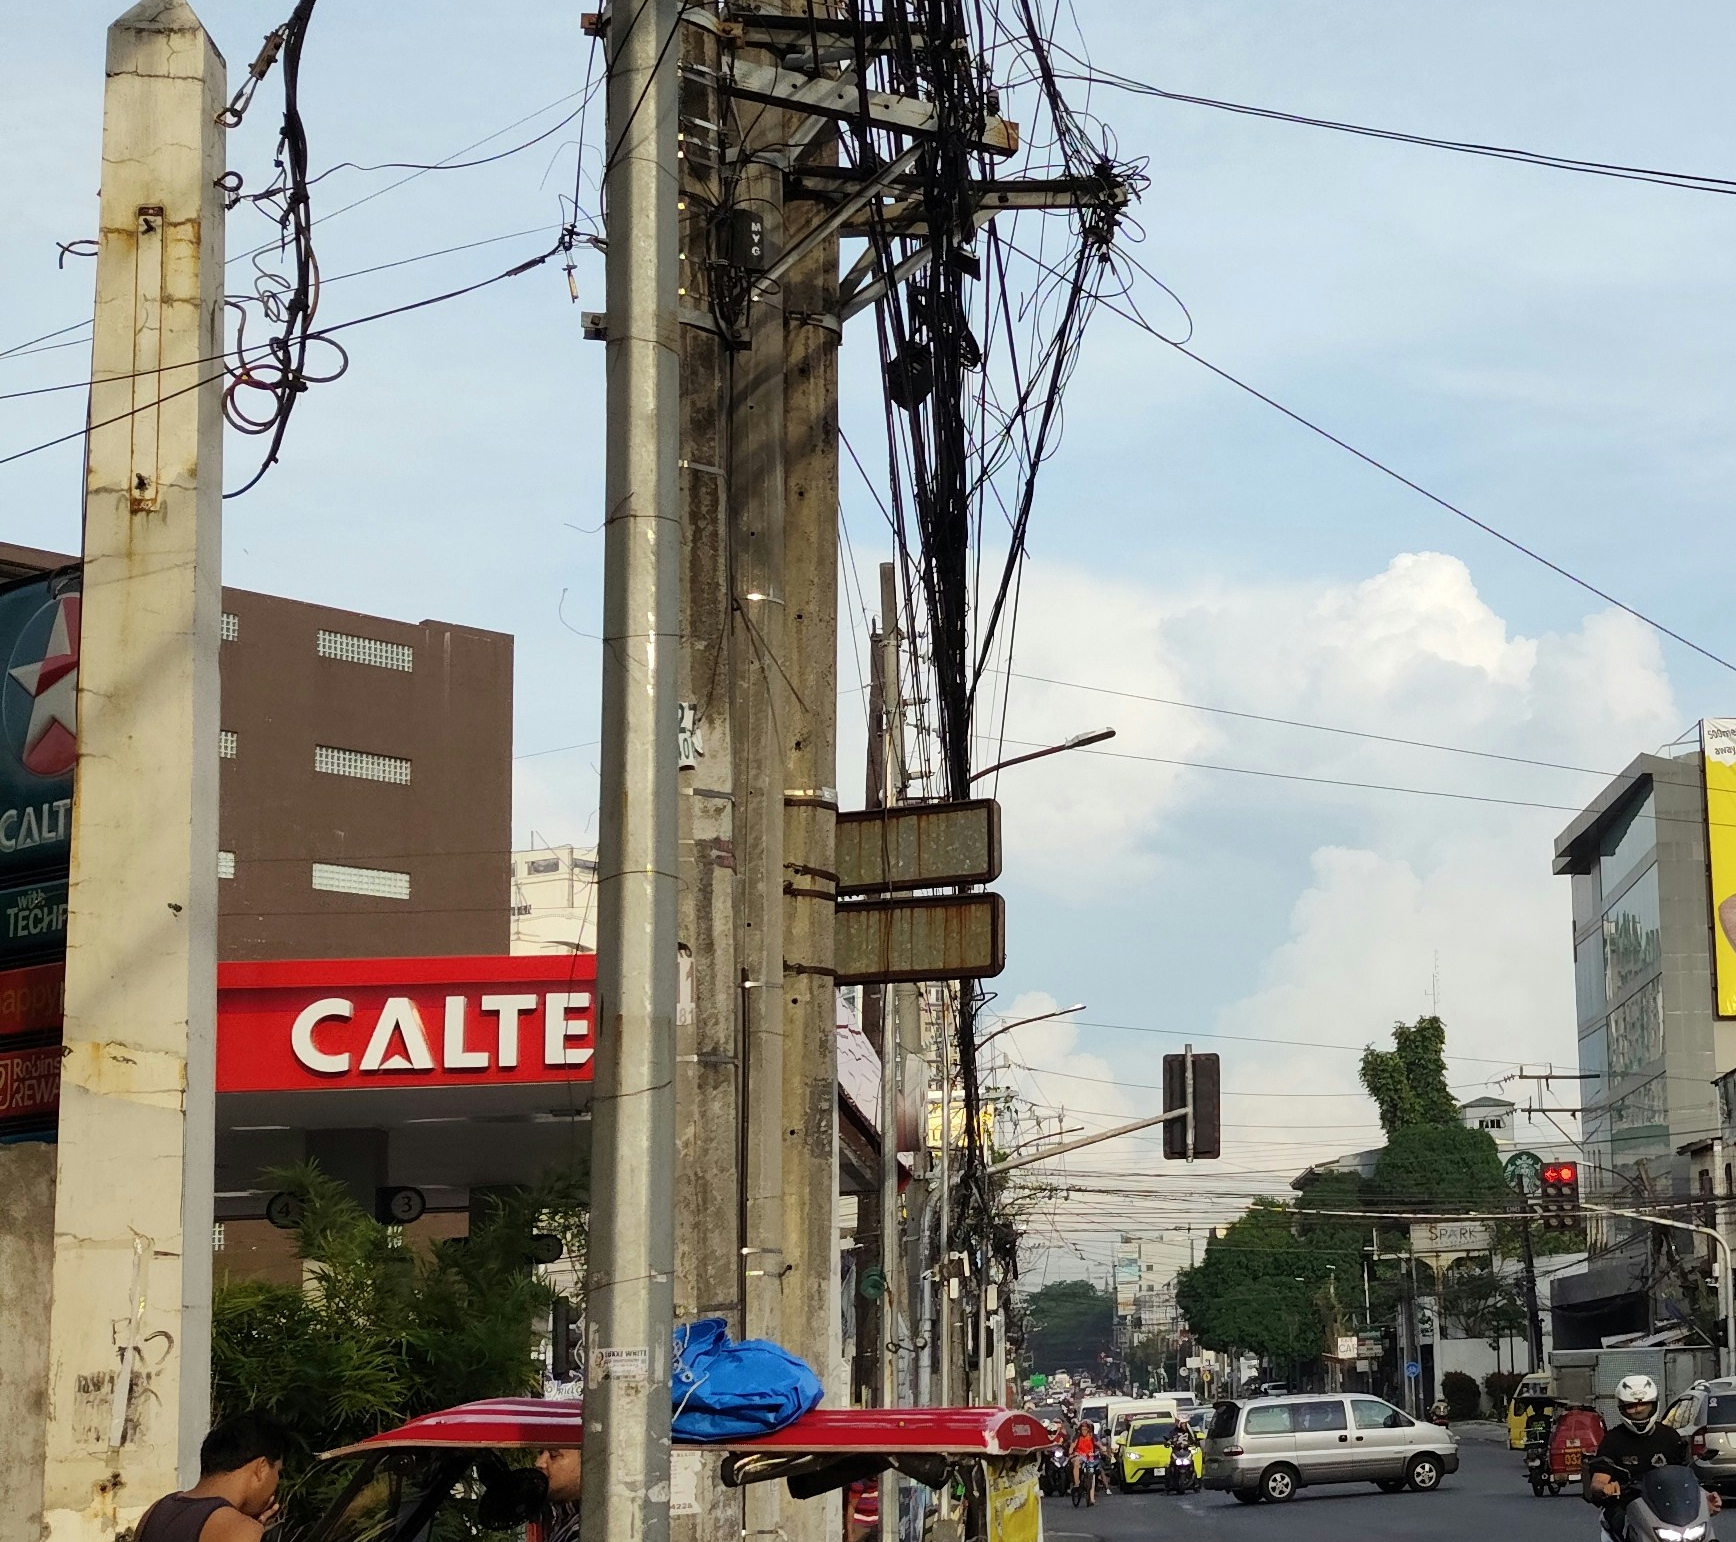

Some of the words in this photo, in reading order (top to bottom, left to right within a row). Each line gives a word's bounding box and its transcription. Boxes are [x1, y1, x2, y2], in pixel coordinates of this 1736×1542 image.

[1714, 746, 1736, 756] away
[17, 889, 46, 909] with
[277, 1202, 291, 1217] 4
[1428, 1226, 1477, 1241] SPARK
